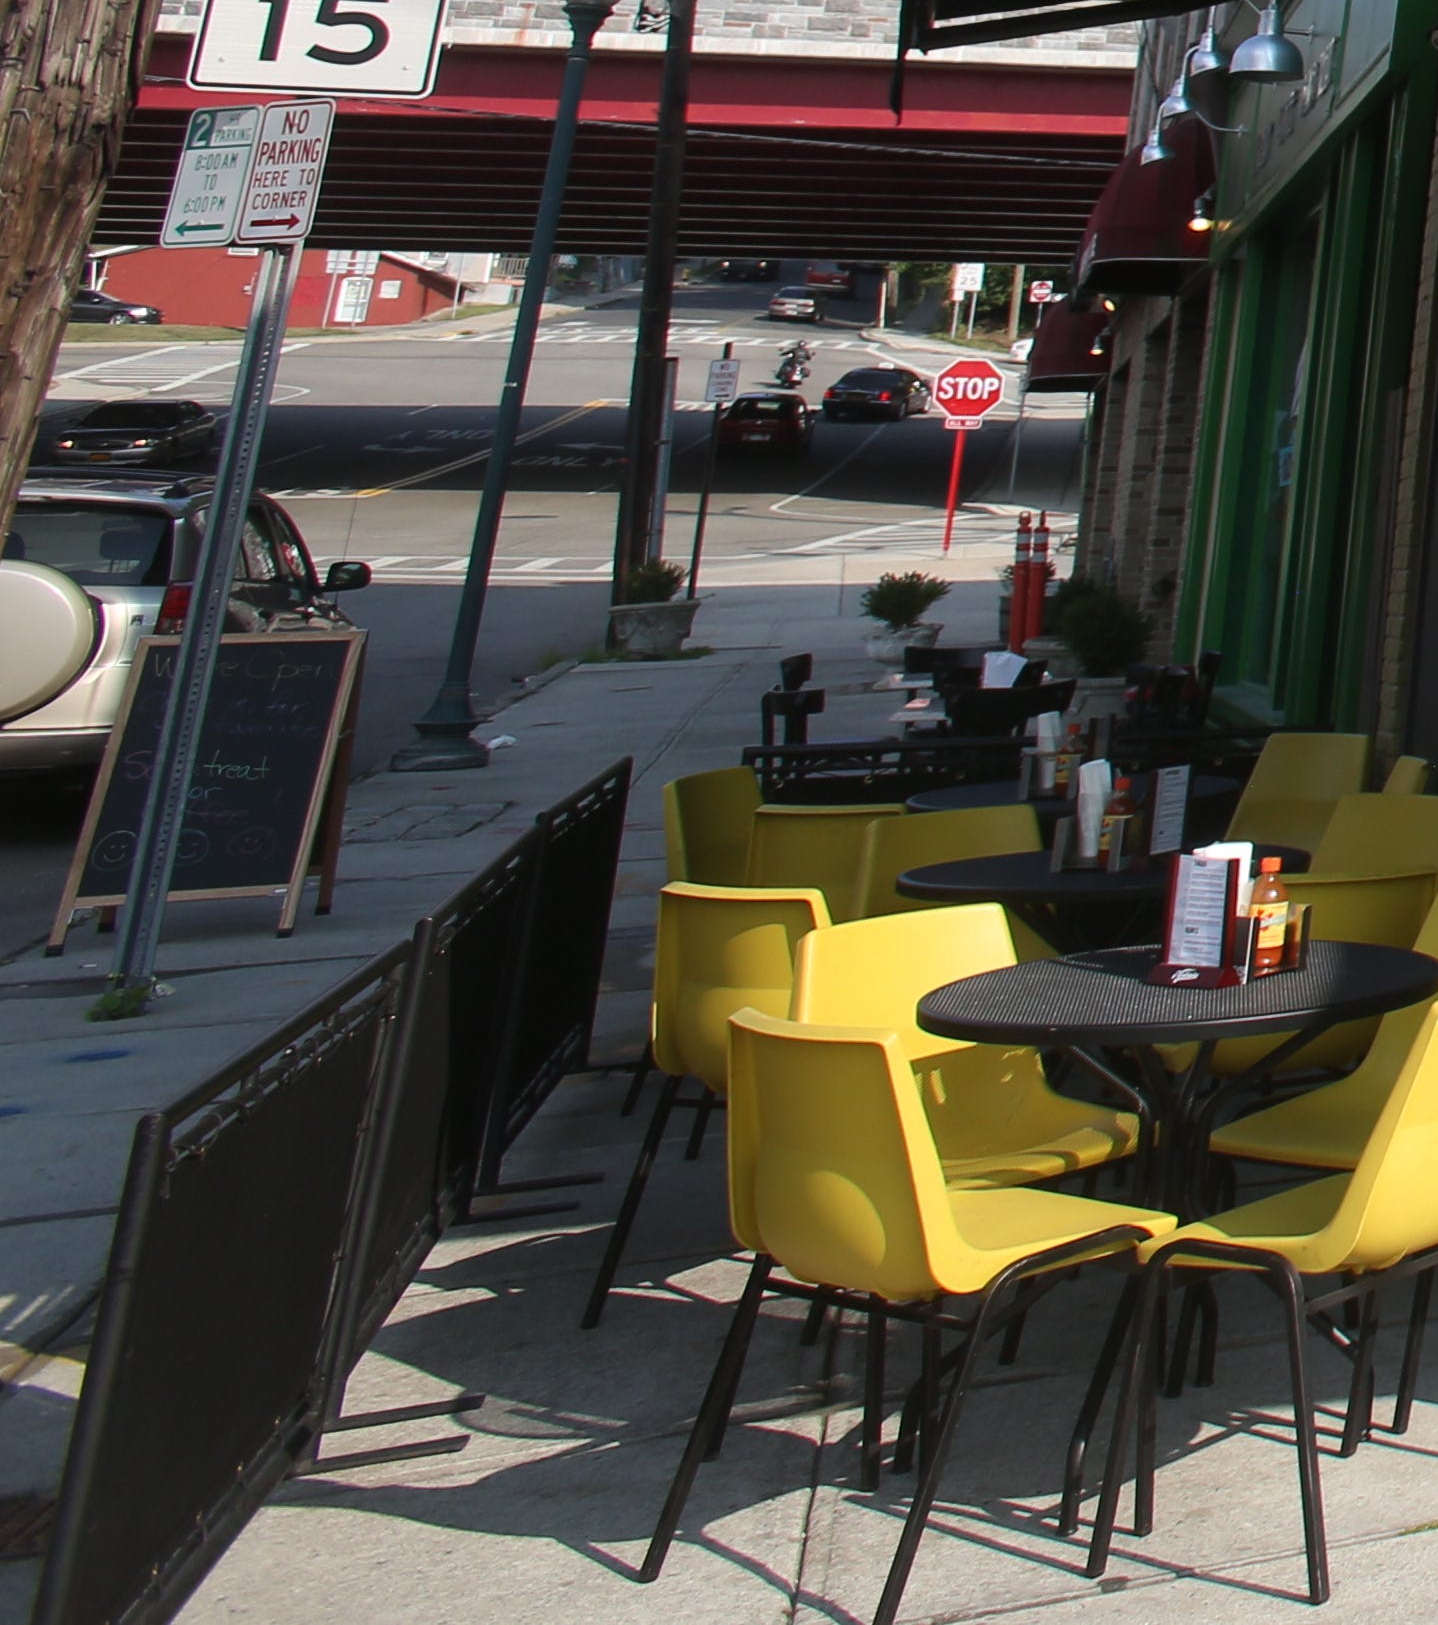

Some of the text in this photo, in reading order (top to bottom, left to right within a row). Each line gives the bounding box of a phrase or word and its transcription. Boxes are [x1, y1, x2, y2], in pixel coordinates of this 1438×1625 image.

[191, 112, 213, 147] 2
[281, 109, 310, 135] NO
[257, 138, 322, 166] PARKING
[203, 174, 217, 190] TO
[252, 168, 316, 188] HERE TO
[252, 190, 308, 210] CORNER
[938, 377, 1000, 400] STOP
[203, 749, 270, 780] treat
